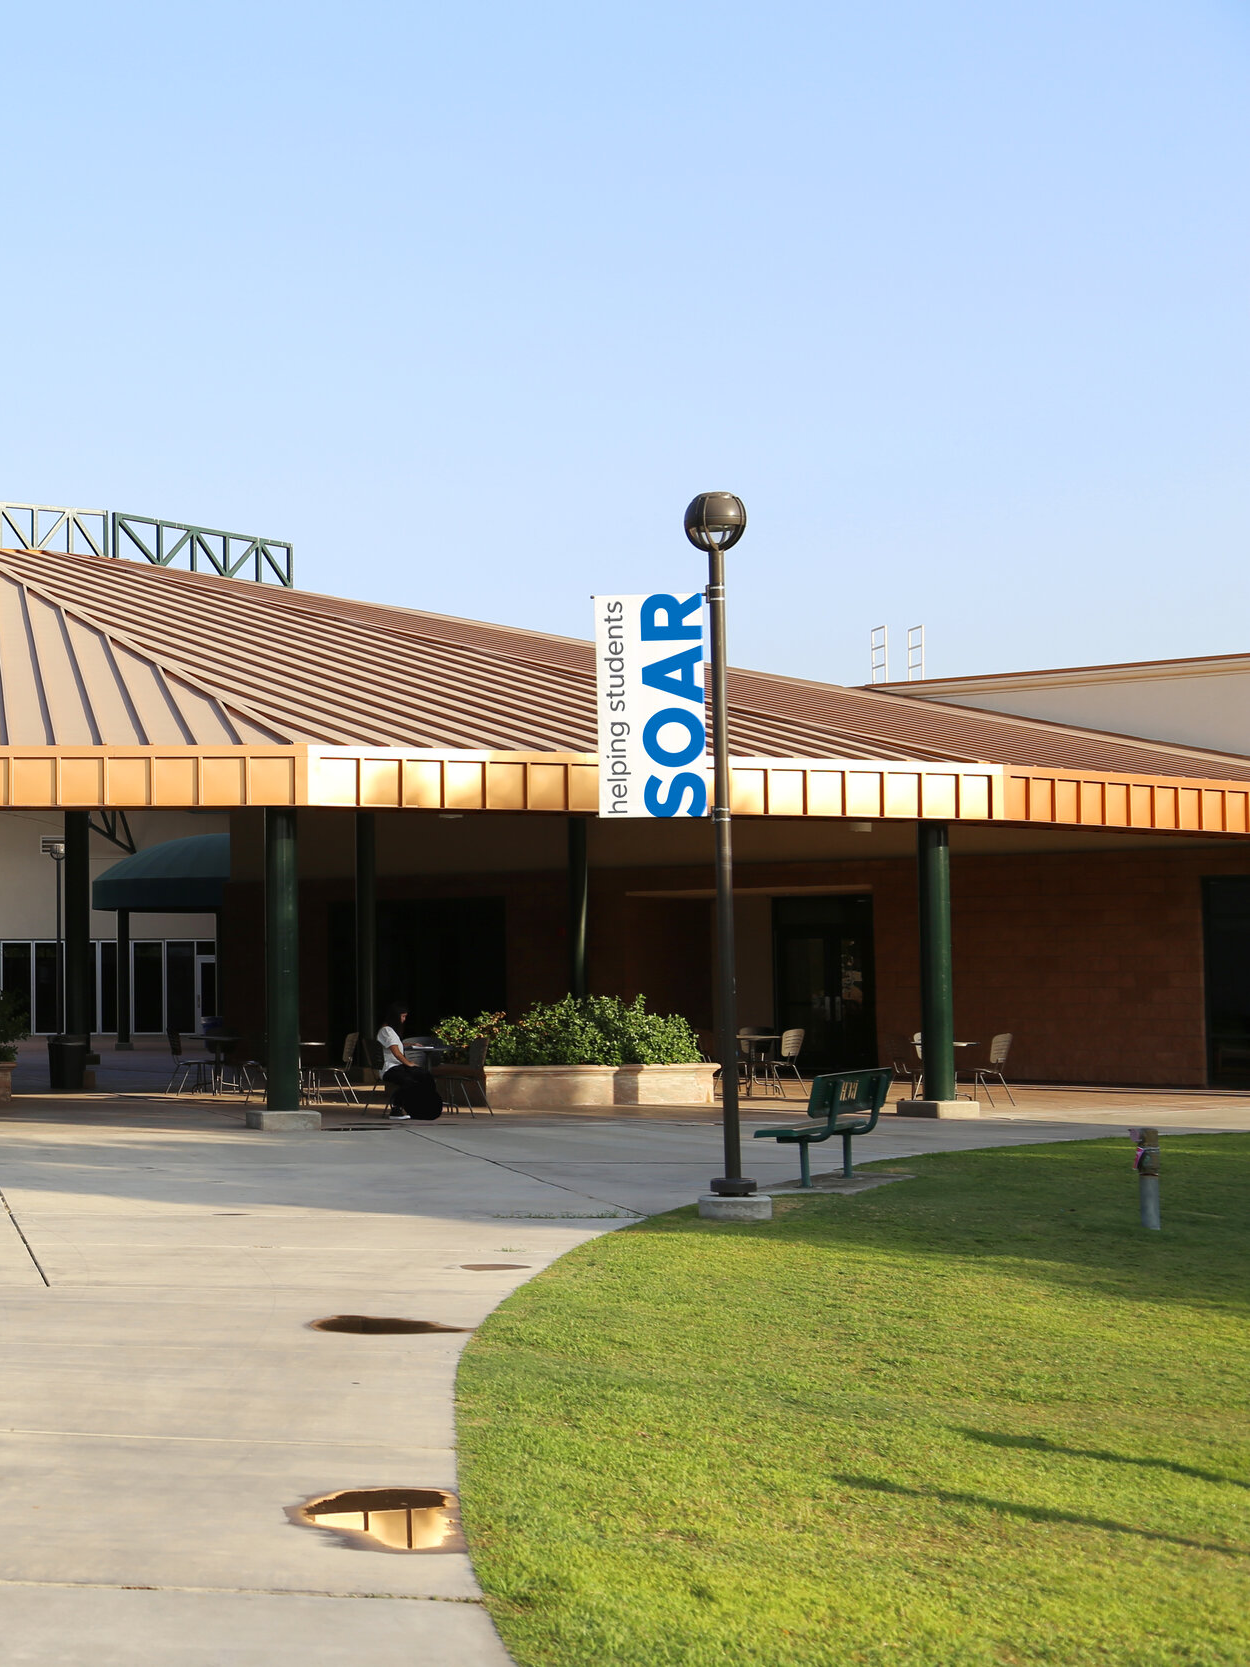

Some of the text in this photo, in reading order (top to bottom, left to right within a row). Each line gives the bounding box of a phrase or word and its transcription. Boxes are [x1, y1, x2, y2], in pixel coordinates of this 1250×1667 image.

[604, 600, 632, 814] helping students
[640, 592, 707, 818] SOAR
